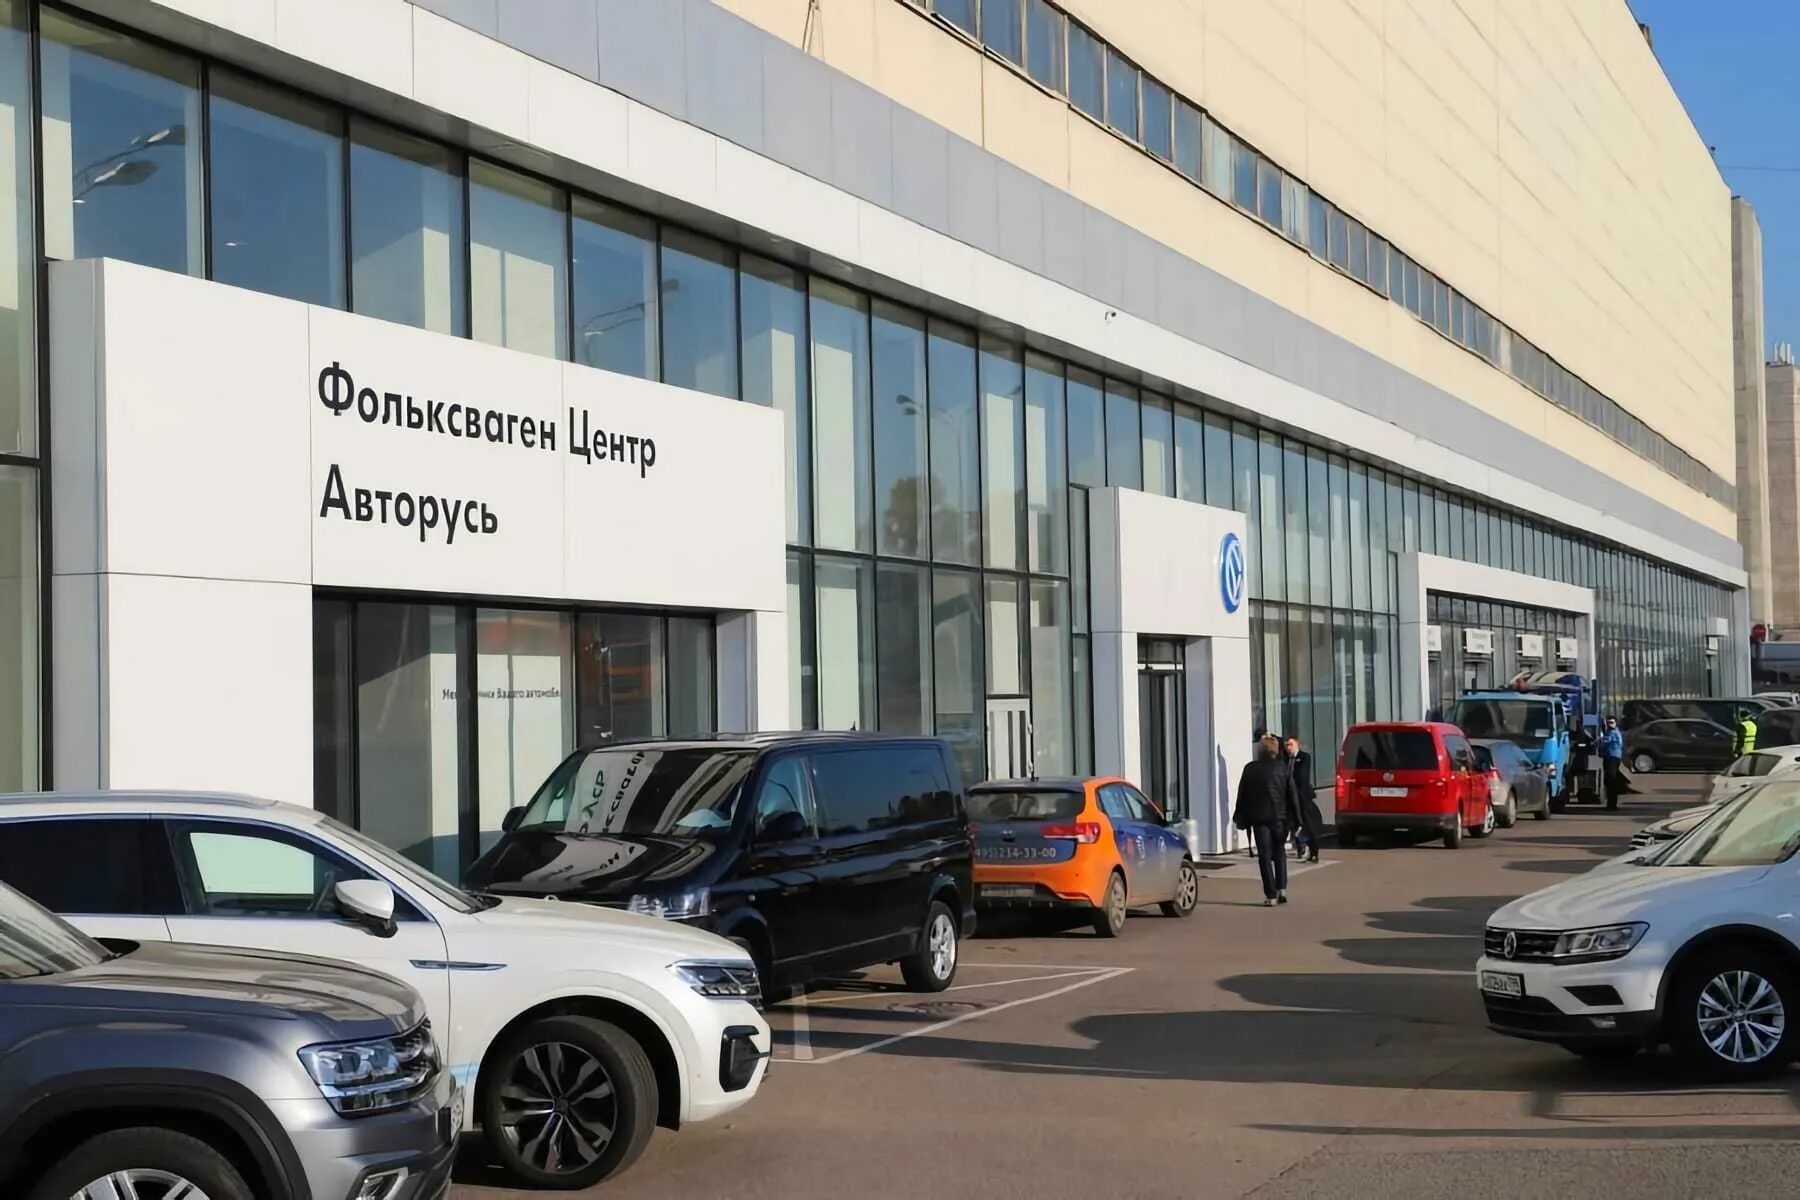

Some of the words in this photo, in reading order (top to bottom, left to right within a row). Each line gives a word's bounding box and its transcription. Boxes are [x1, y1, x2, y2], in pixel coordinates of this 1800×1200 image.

[318, 361, 556, 451] Фольксваген
[569, 406, 656, 478] Центр
[319, 463, 498, 544] Авторусь
